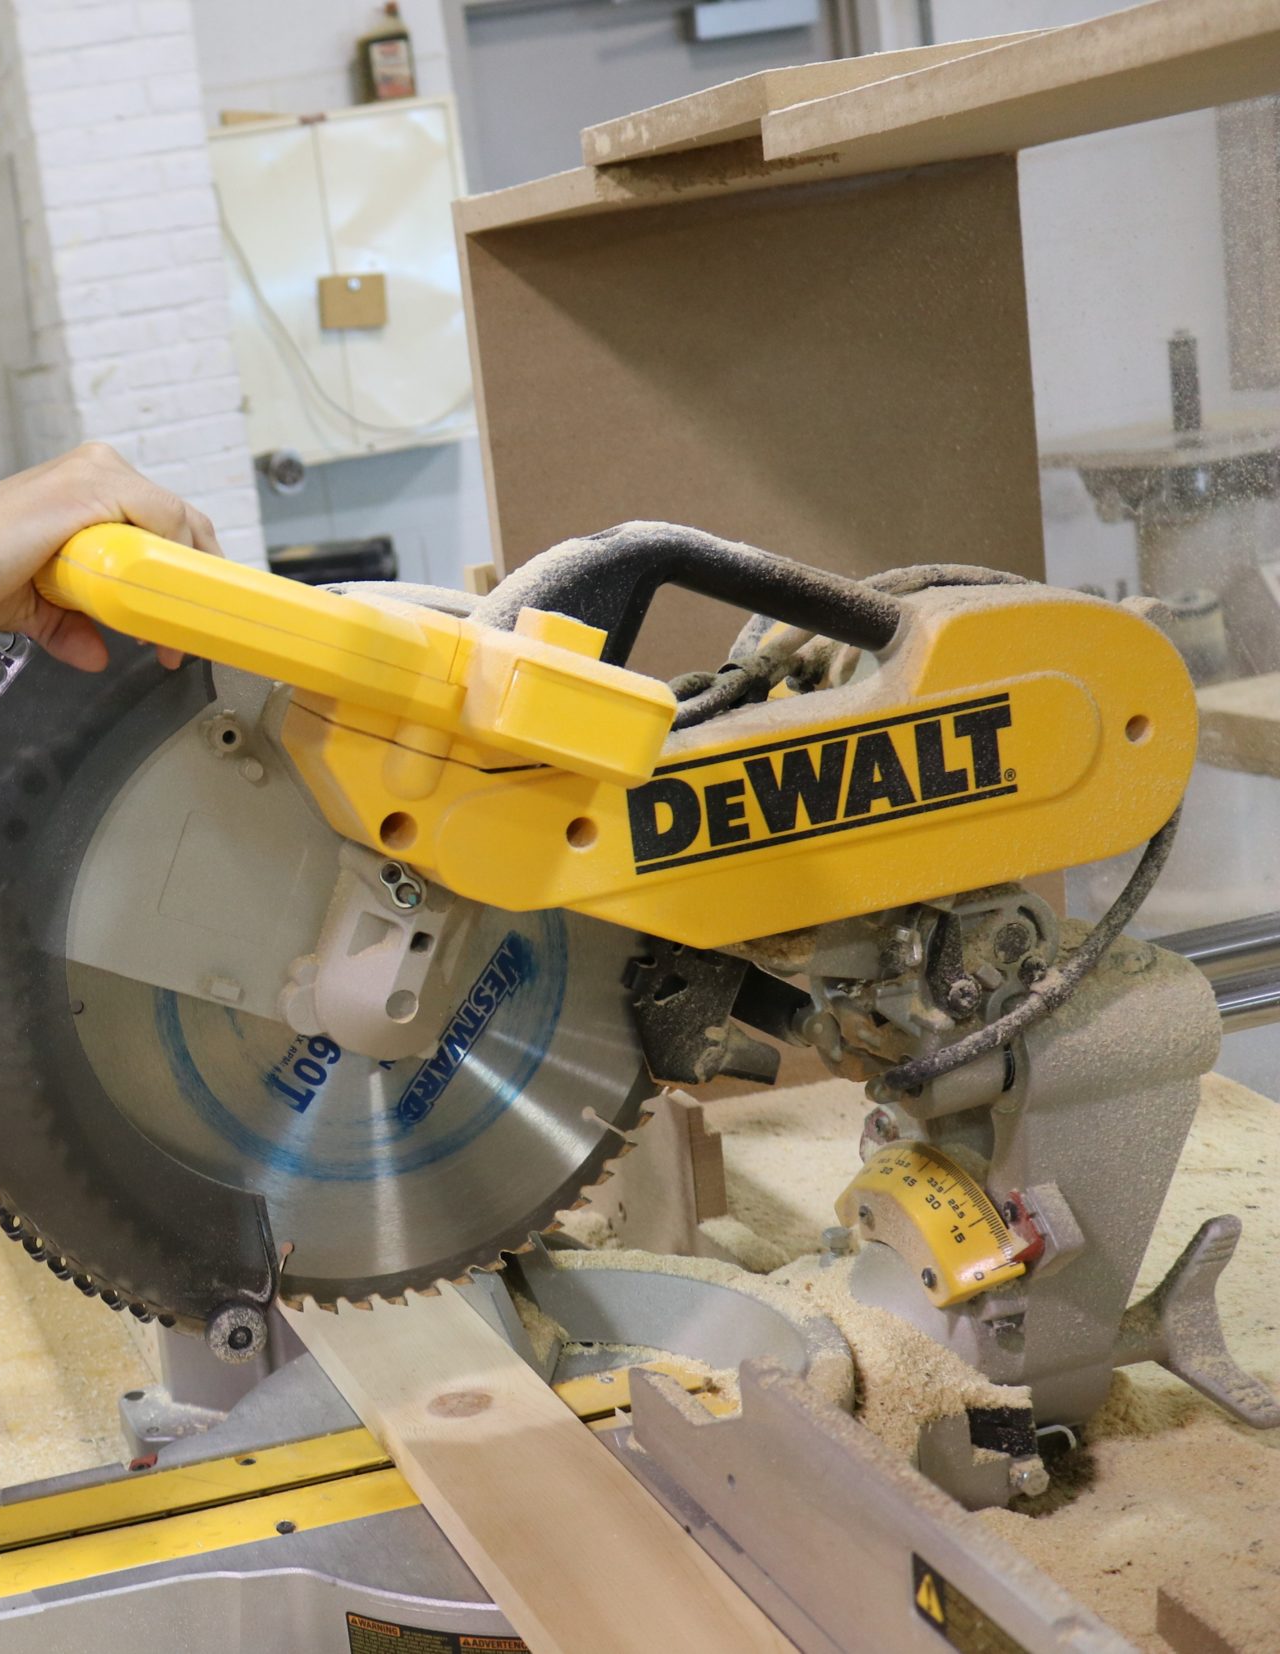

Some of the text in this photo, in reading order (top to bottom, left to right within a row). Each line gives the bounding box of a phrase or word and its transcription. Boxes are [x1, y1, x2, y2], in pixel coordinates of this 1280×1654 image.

[902, 1175, 918, 1187] 45
[925, 1194, 942, 1210] 30
[949, 1225, 966, 1244] 15
[472, 1639, 527, 1649] ADVERTENC
